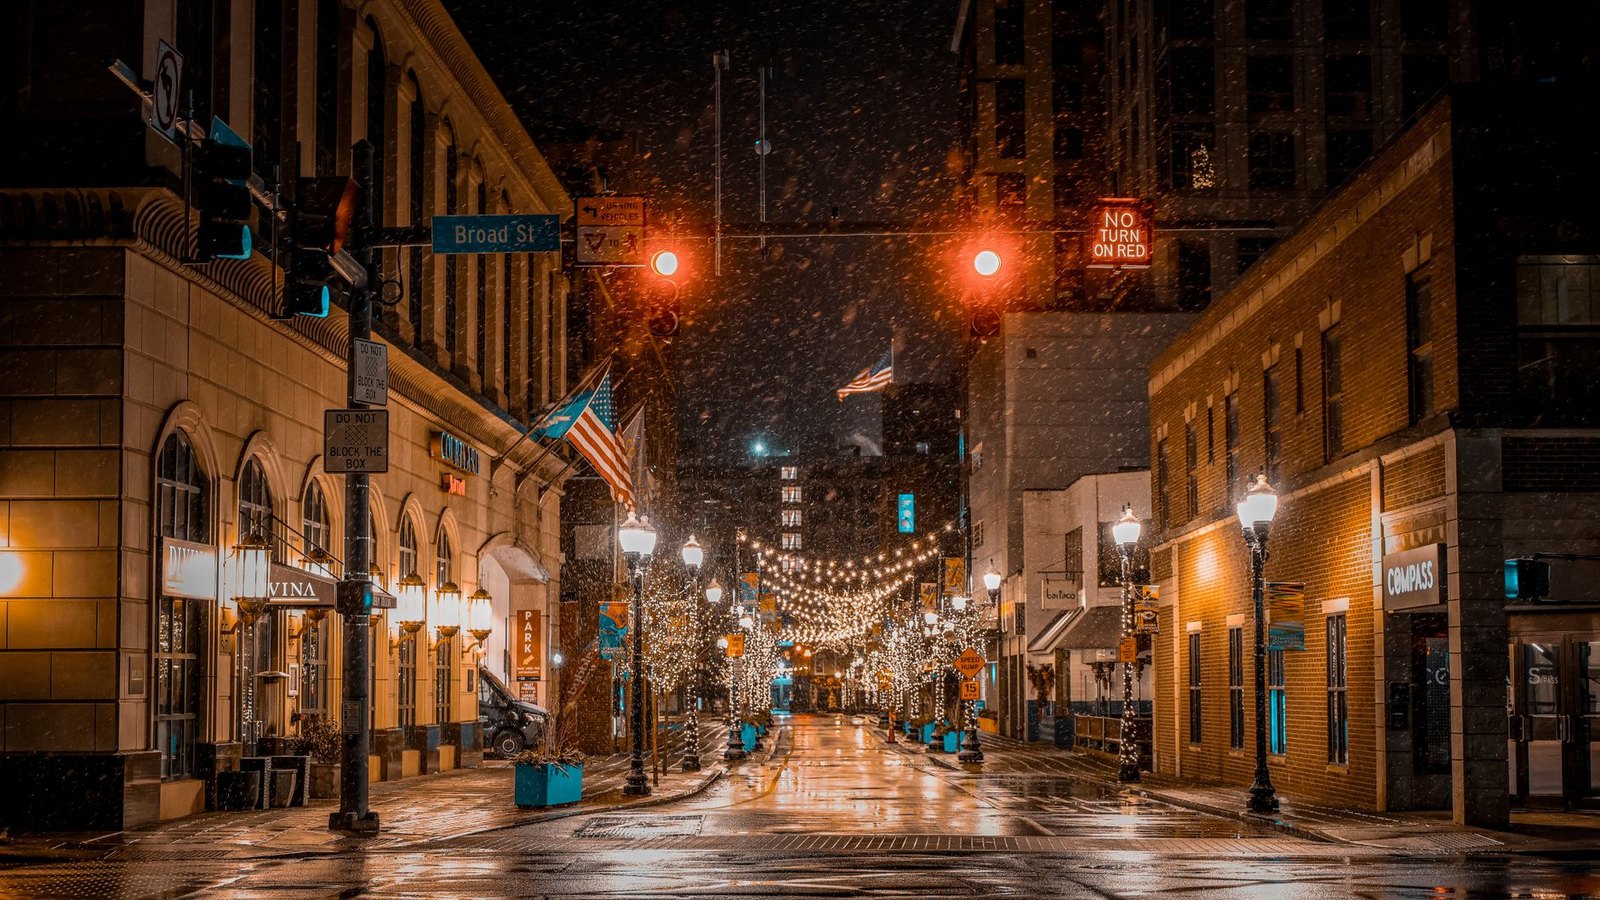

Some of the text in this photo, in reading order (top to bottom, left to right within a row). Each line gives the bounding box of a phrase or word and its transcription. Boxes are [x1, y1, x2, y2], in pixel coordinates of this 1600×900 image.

[1105, 212, 1134, 227] NO
[455, 224, 534, 244] Broad St
[1100, 229, 1139, 242] TURN
[1094, 244, 1145, 257] ON RED
[360, 343, 382, 356] DO NOT
[358, 376, 385, 390] BLOCK THE
[365, 389, 376, 400] BOX
[336, 413, 377, 424] DO NOT
[330, 446, 382, 457] BLOCK THE
[346, 458, 366, 469] BOX
[1387, 560, 1434, 596] COMPASS
[1046, 588, 1075, 600] bartaco
[524, 611, 533, 653] PARK
[965, 684, 977, 692] 15
